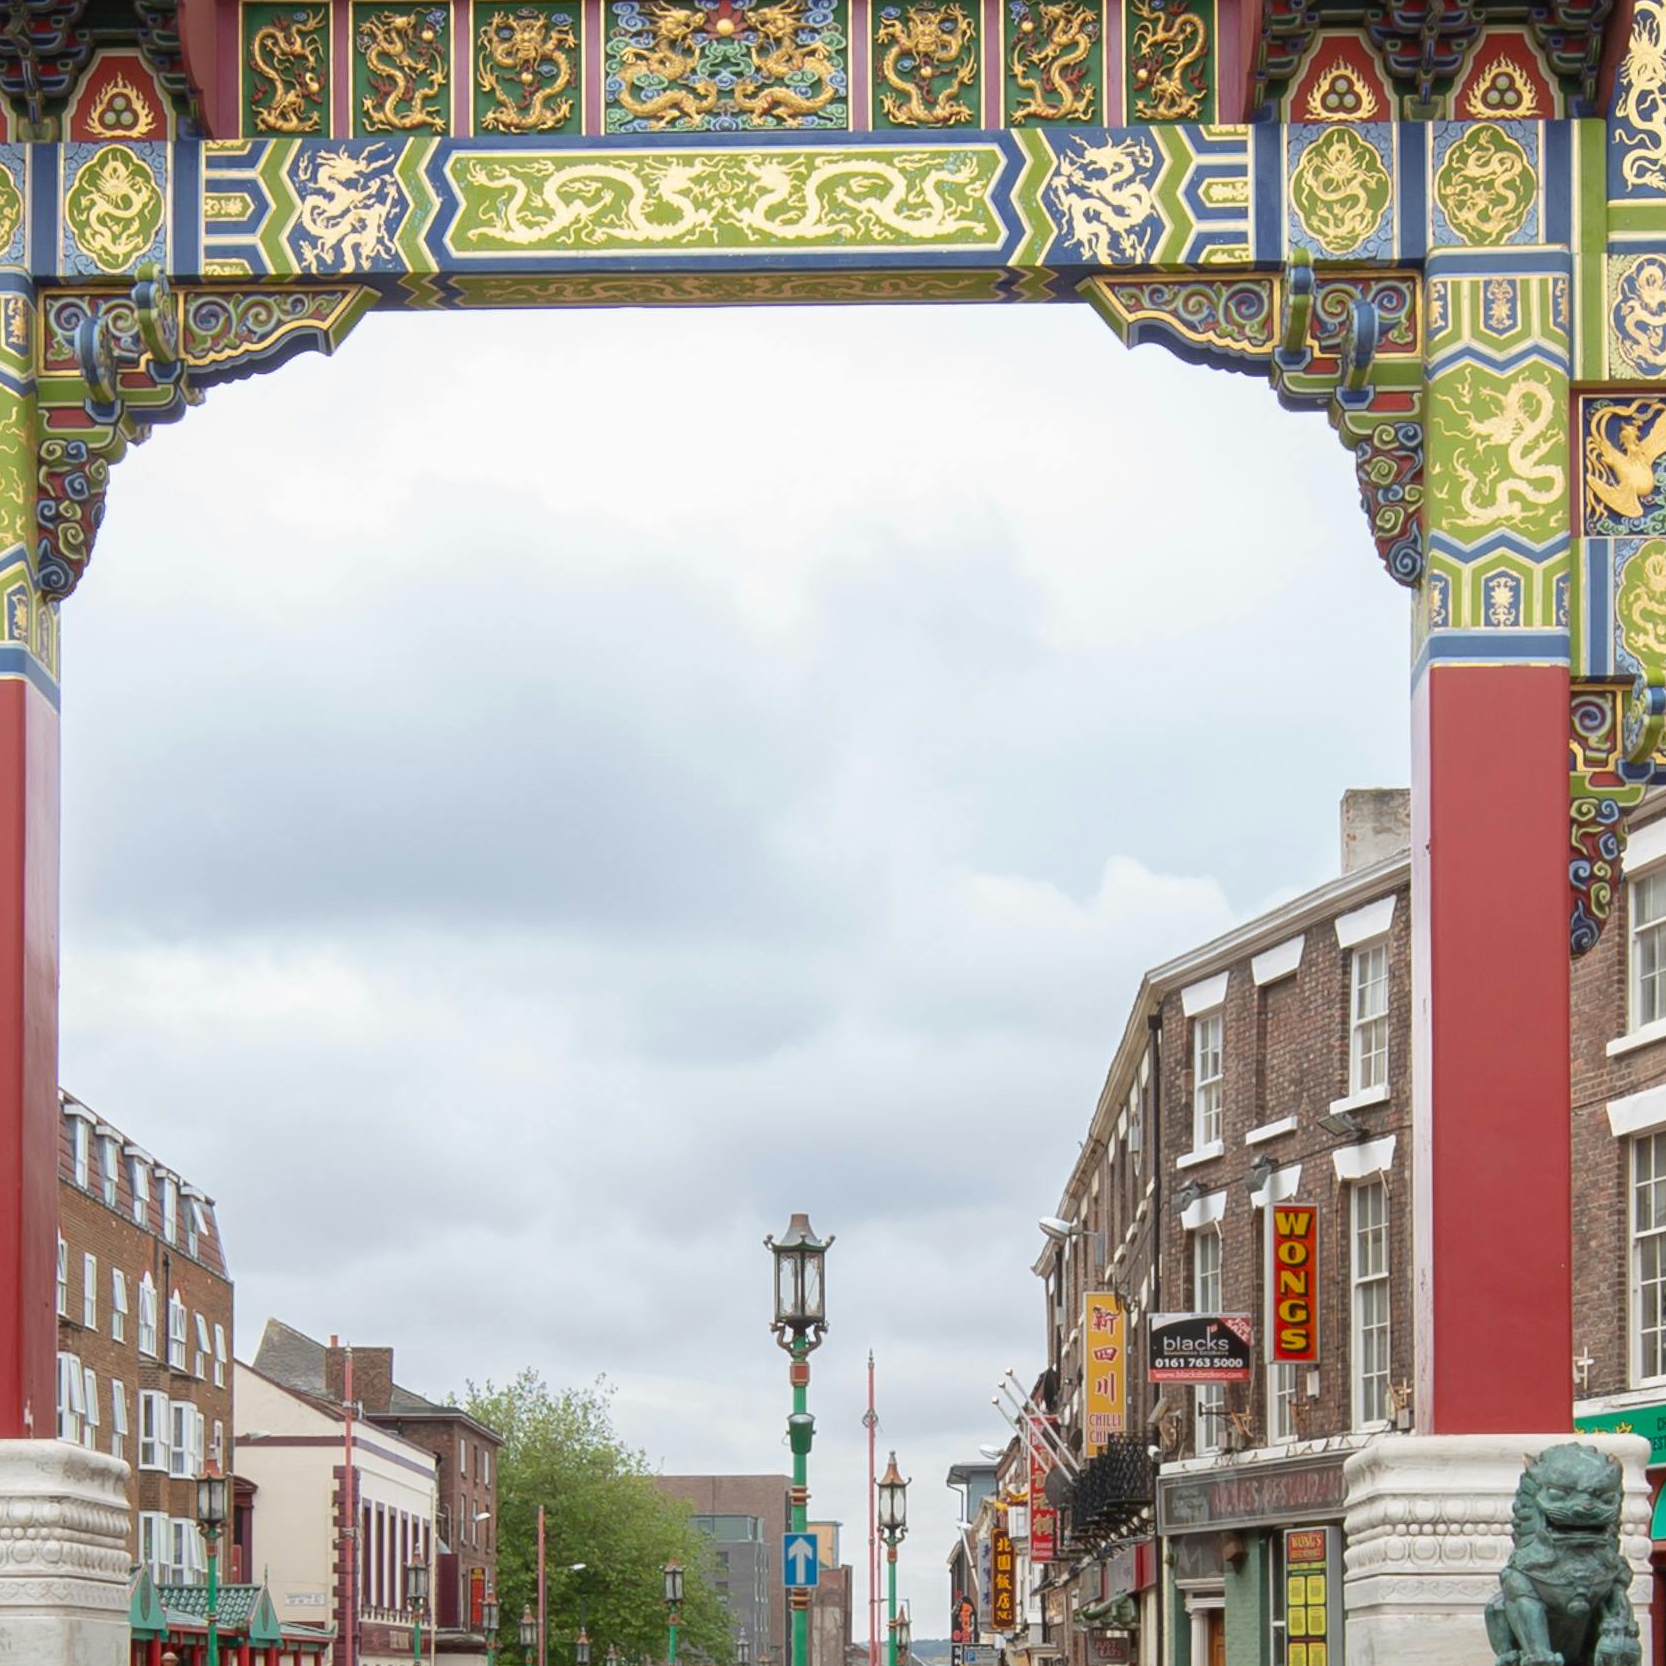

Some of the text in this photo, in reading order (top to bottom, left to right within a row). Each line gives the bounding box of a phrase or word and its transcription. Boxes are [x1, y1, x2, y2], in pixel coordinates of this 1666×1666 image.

[1275, 1212, 1312, 1353] WONGS
[1163, 1325, 1229, 1350] blacks
[1155, 1357, 1243, 1368] 0161 763 5000
[1089, 1413, 1121, 1427] CHILLI
